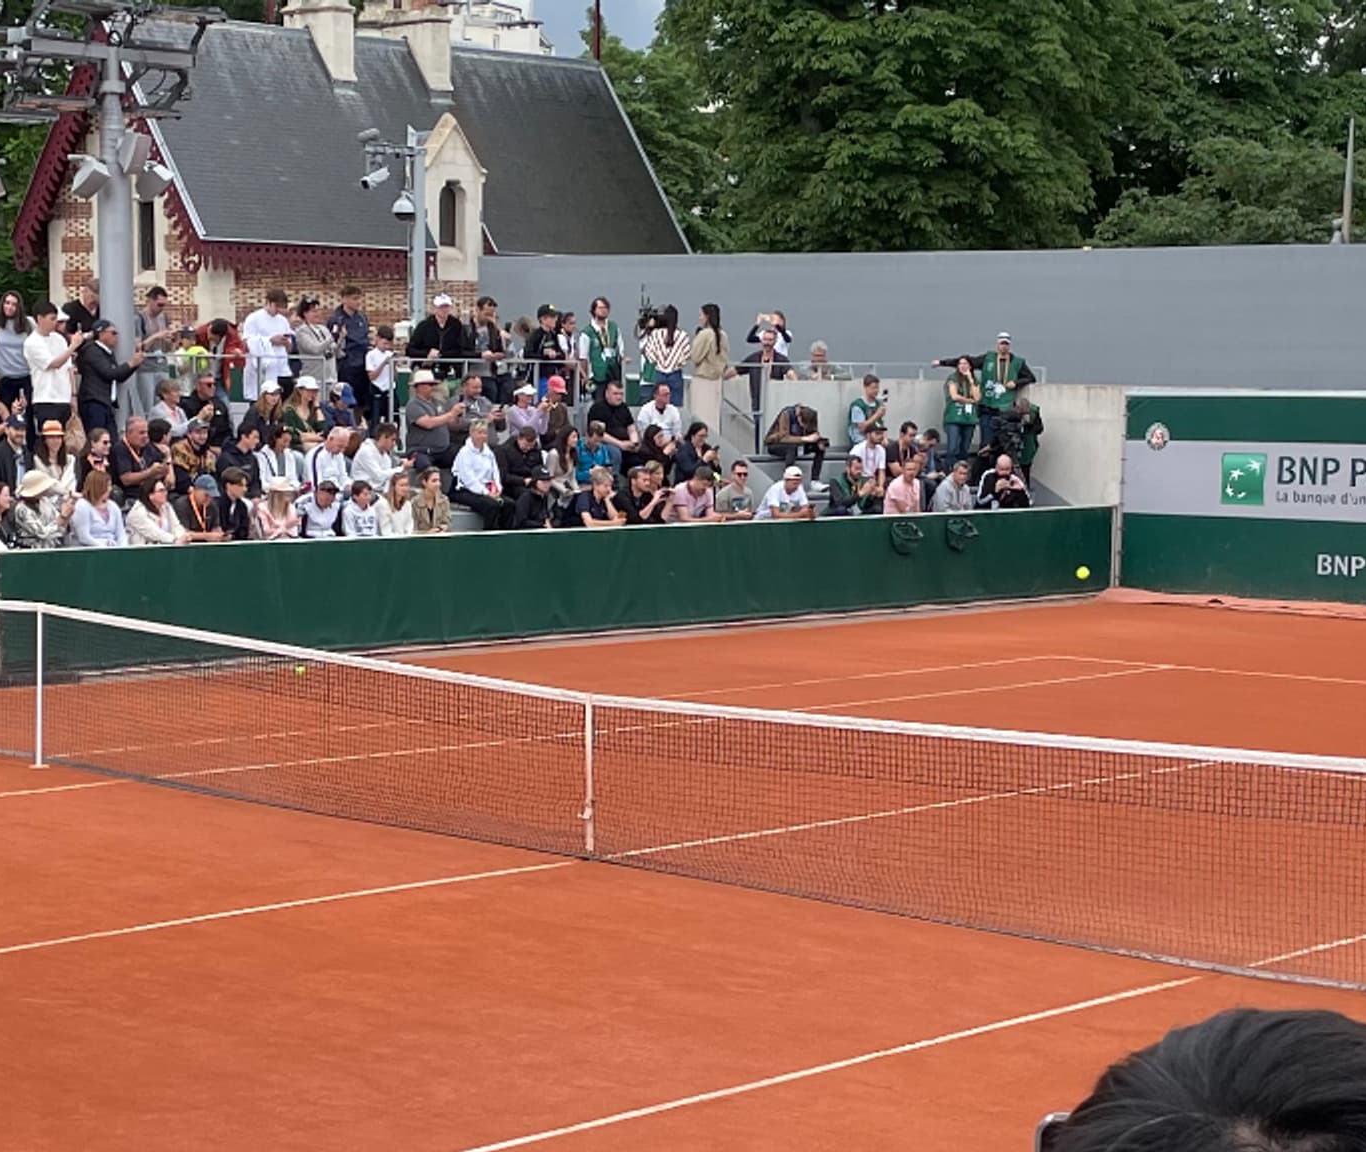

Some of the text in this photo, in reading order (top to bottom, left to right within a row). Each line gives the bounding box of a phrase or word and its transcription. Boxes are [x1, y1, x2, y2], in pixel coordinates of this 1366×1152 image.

[1276, 456, 1340, 486] BNP
[1275, 491, 1289, 503] La
[1293, 491, 1336, 507] banque
[1341, 493, 1366, 506] d'un
[1316, 554, 1366, 578] BNP
